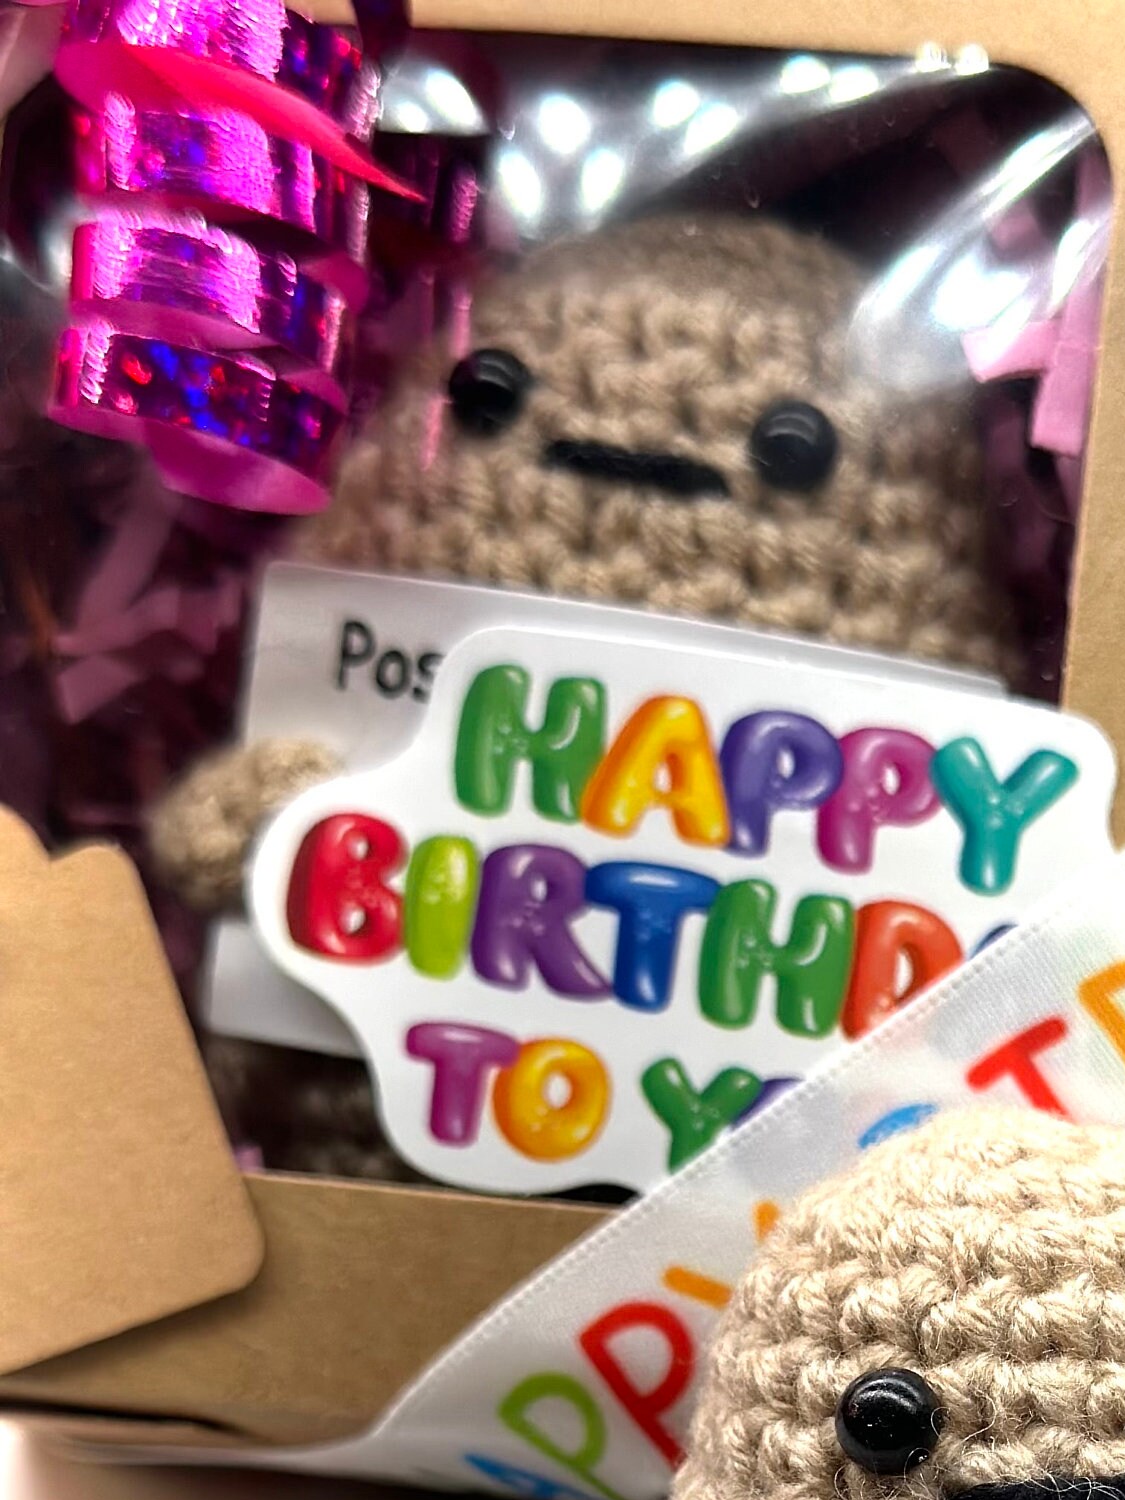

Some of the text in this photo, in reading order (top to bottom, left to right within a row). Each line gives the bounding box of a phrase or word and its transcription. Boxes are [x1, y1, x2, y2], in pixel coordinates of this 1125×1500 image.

[454, 665, 1077, 895] HAPPY
[286, 813, 1018, 1039] BIRTHD
[405, 1022, 611, 1162] TO
